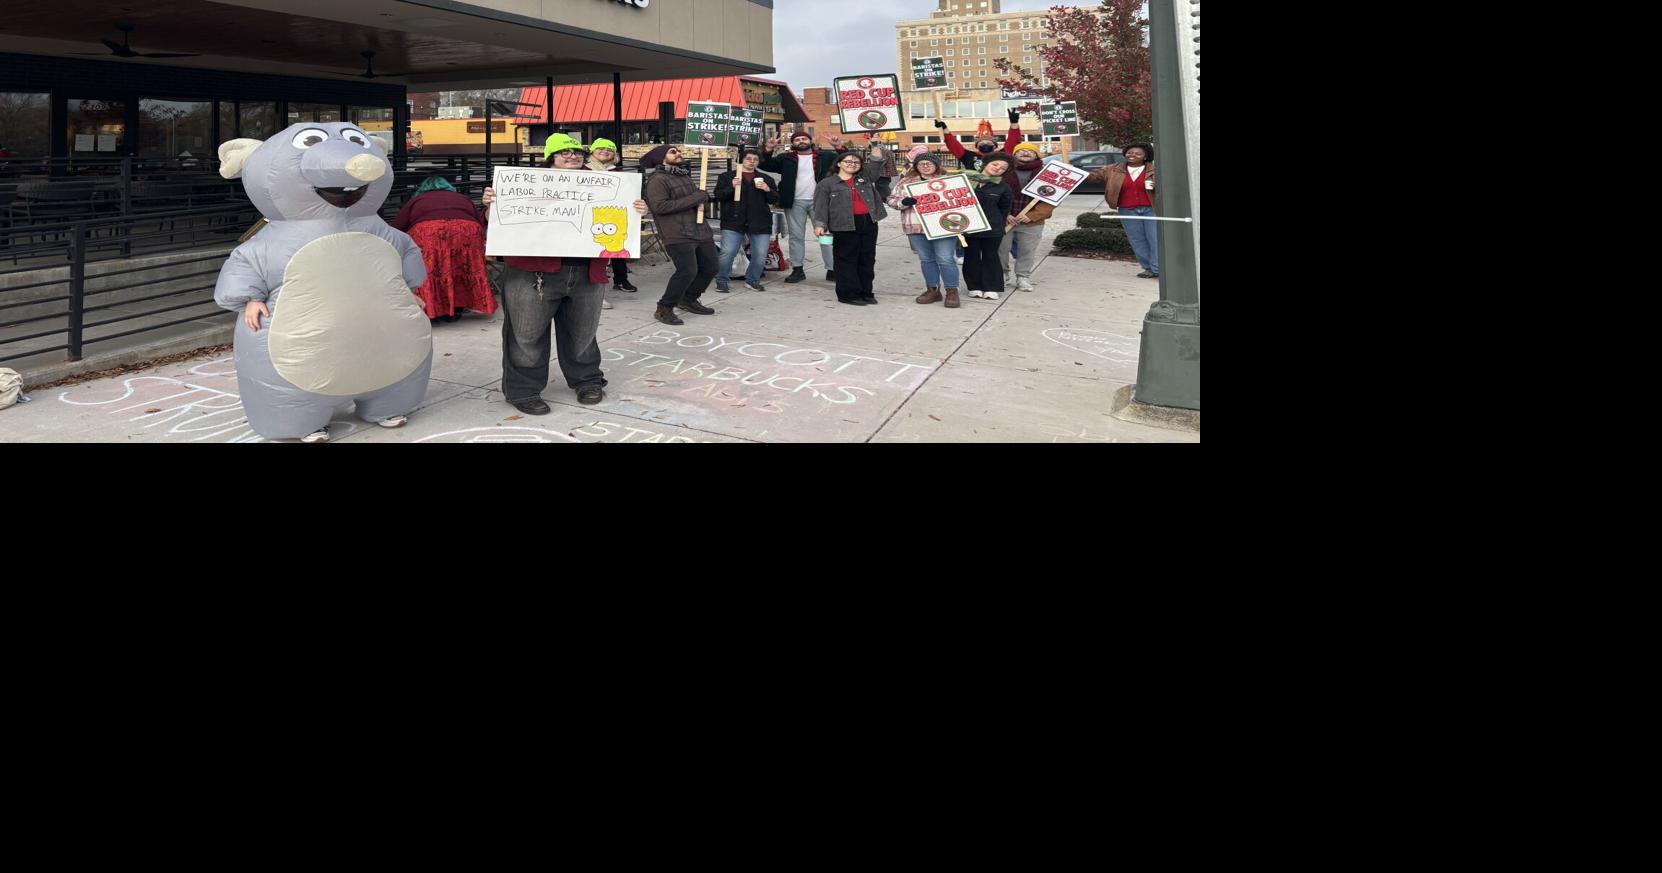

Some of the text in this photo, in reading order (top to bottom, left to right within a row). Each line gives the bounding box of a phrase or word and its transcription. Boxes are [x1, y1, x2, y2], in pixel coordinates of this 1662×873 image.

[840, 87, 895, 99] RED CUP
[840, 98, 899, 109] REBELLION
[688, 111, 729, 120] BARISTAS
[730, 115, 762, 124] BARISTAS
[687, 123, 727, 131] STRIKE!
[729, 125, 760, 133] STRIKE!
[501, 172, 615, 186] WE'RE ON AN UNFAIR
[501, 187, 594, 201] LABOR PRACTICE
[943, 187, 970, 200] CUP
[552, 204, 580, 218] MAN!
[915, 196, 977, 214] REBELLION
[634, 330, 933, 383] BOYCOTT
[600, 348, 873, 404] STARBUCKS
